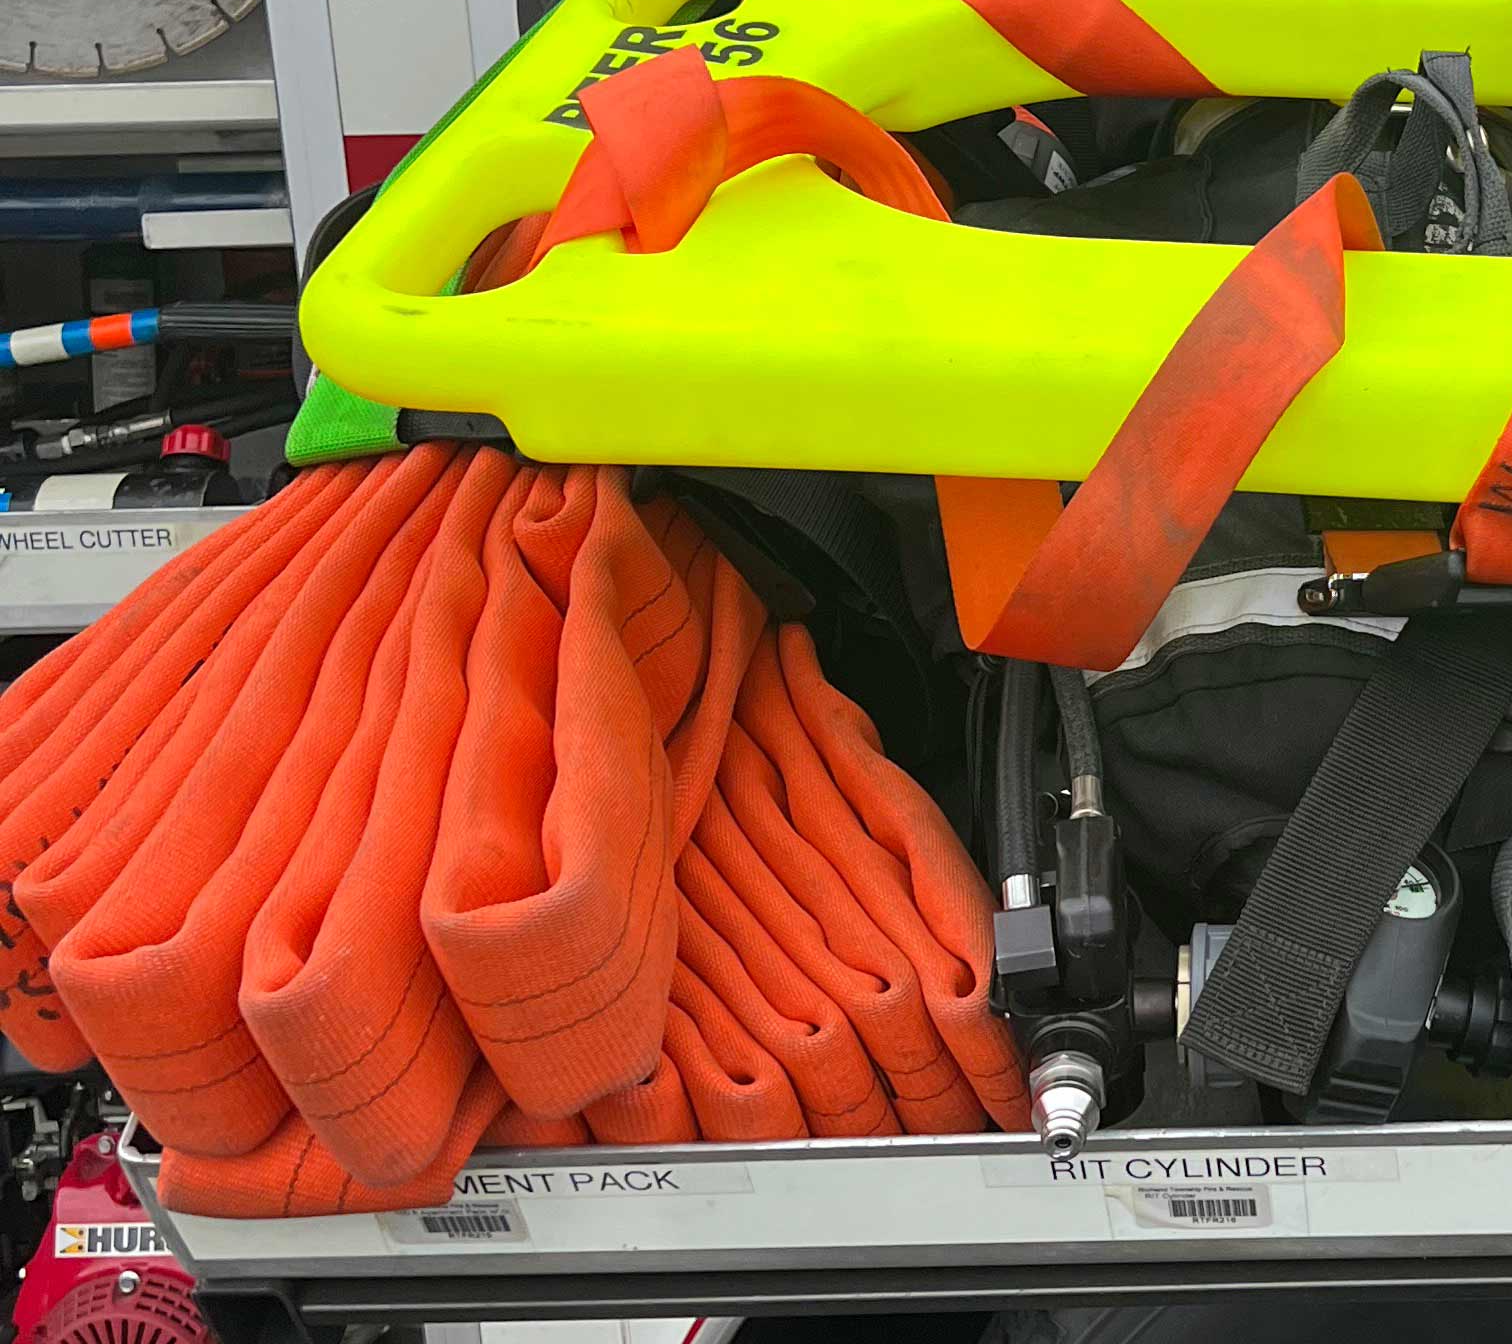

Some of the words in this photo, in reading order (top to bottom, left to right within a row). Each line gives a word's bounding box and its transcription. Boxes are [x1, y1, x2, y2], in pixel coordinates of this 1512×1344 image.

[700, 18, 780, 67] 56
[0, 531, 74, 551] WHEEL
[79, 528, 173, 549] CUTTER
[1050, 1159, 1112, 1180] RIT
[1125, 1156, 1327, 1179] CYLINDER
[569, 1169, 680, 1192] PACK
